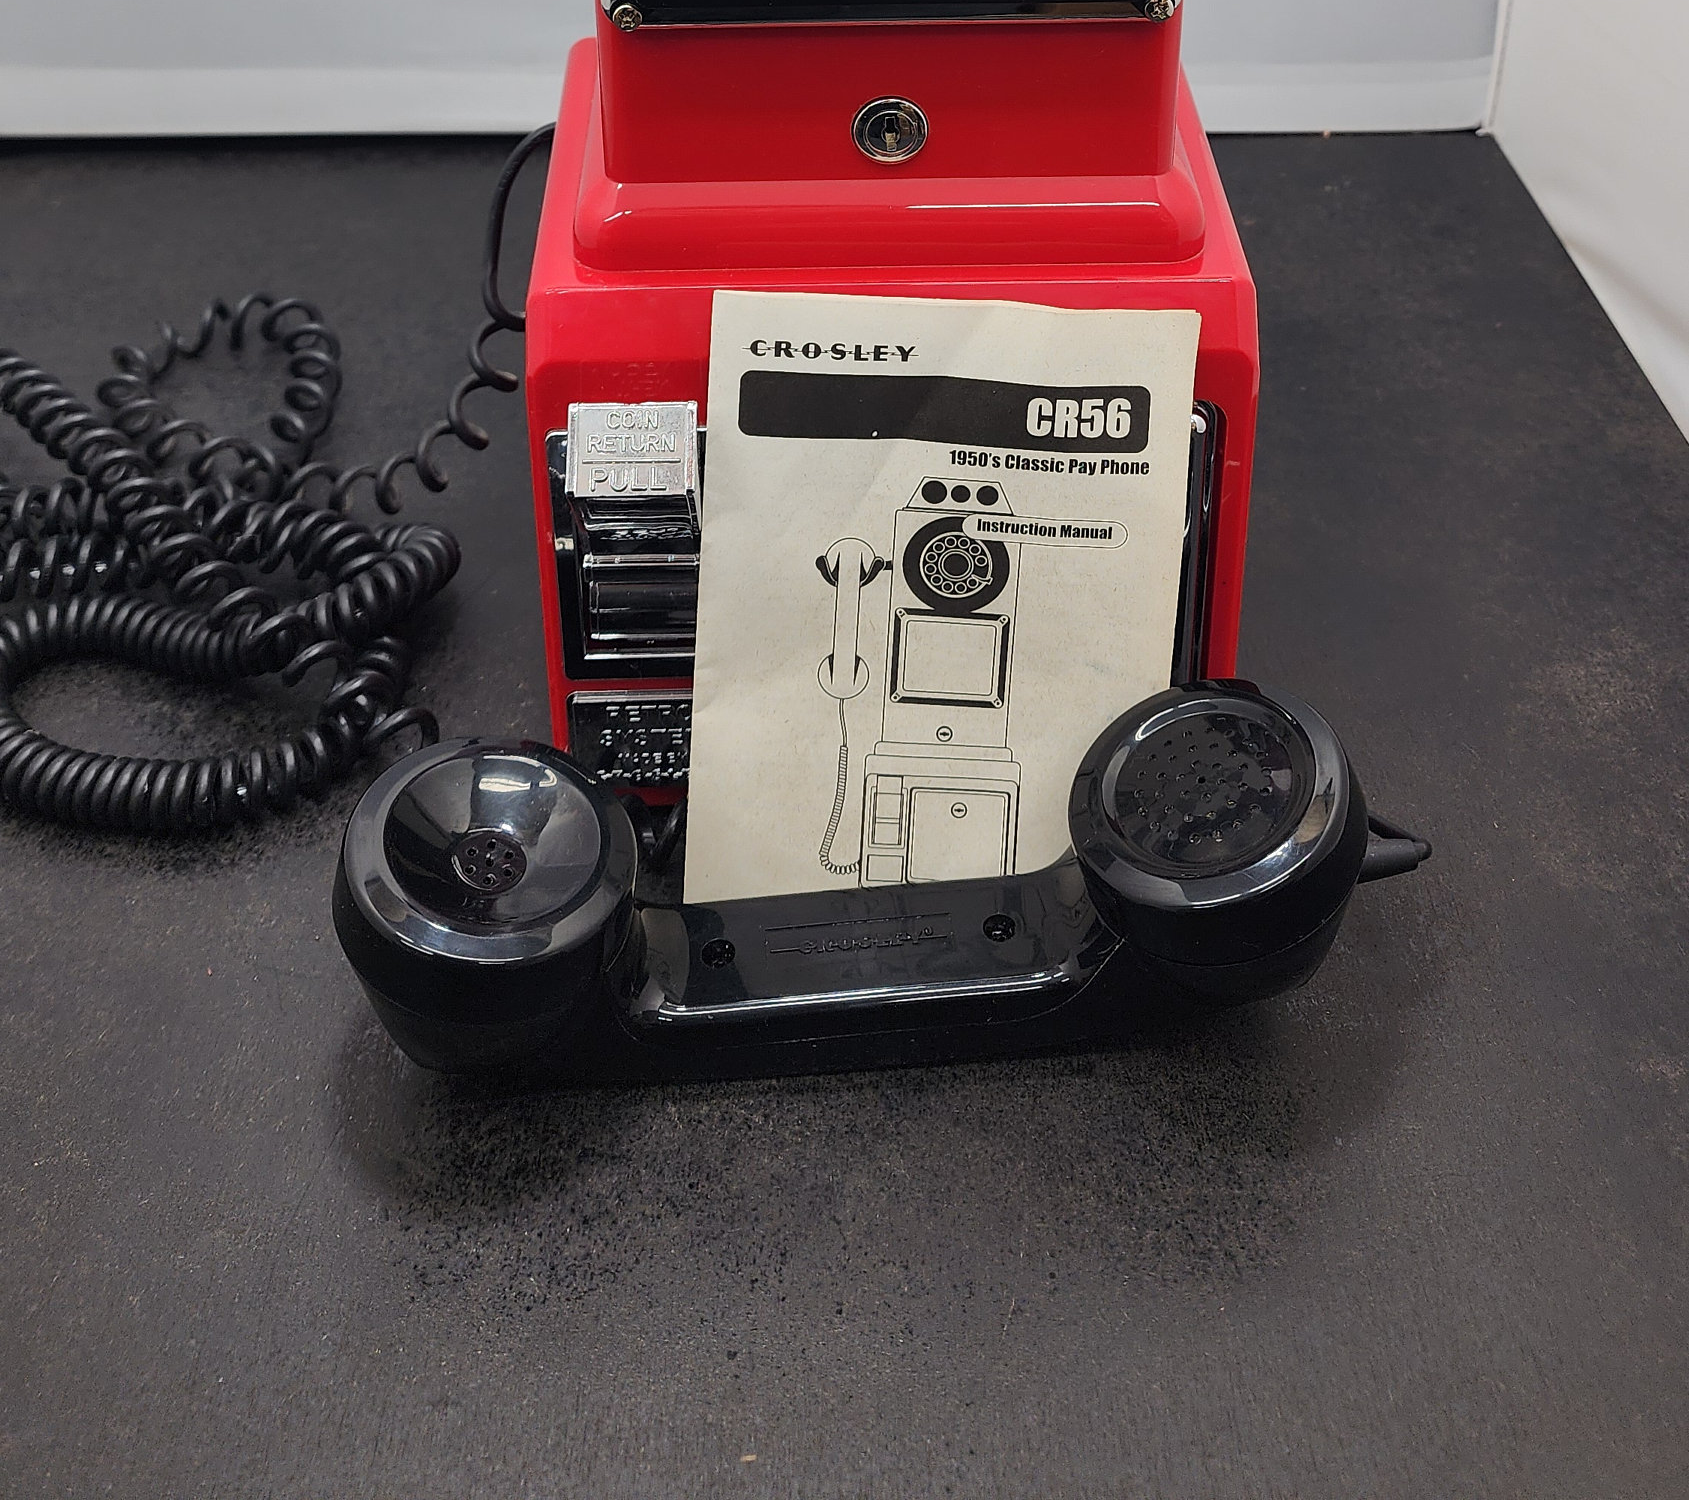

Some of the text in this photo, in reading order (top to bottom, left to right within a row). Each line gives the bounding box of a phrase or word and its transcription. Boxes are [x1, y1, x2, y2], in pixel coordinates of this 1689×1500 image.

[746, 339, 918, 363] CROSLEY
[606, 409, 660, 430] COIN
[1025, 397, 1132, 440] CR56
[586, 431, 677, 454] RETURN
[948, 449, 1150, 476] 1950's Classic Pay Phone
[589, 465, 668, 493] PULL
[976, 518, 1113, 541] Instruction Manual
